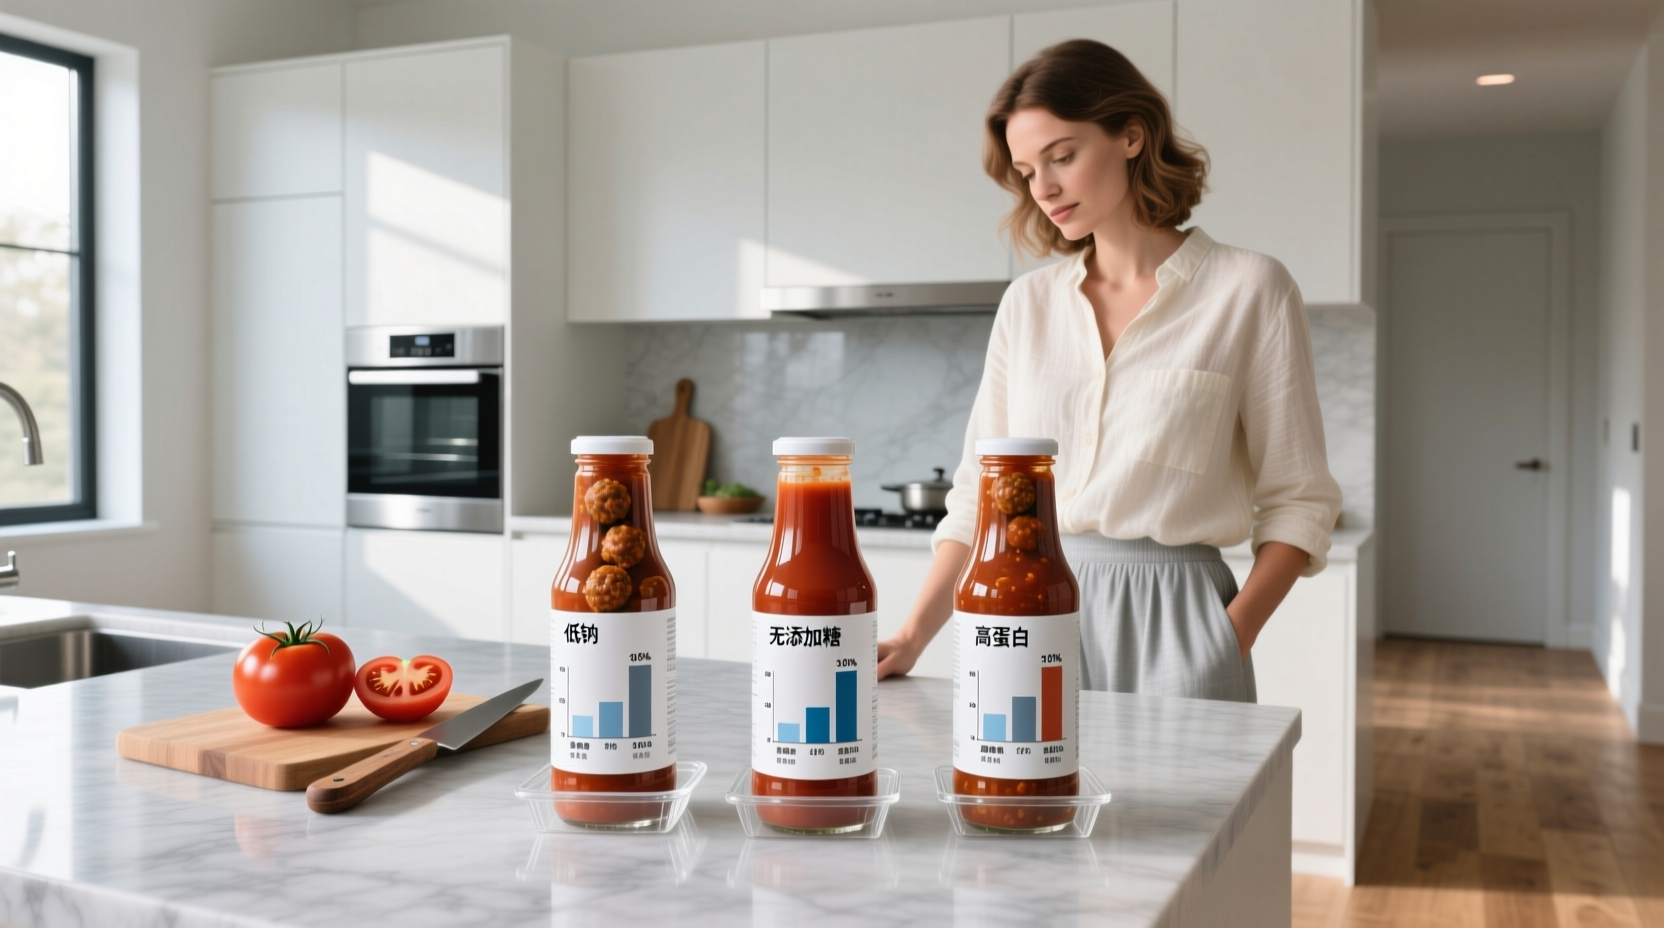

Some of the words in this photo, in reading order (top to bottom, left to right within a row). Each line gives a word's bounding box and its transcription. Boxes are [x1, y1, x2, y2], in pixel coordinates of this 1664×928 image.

[564, 623, 598, 644] 低钠
[769, 625, 842, 648] 无添加糖
[975, 625, 1029, 648] 高蛋白
